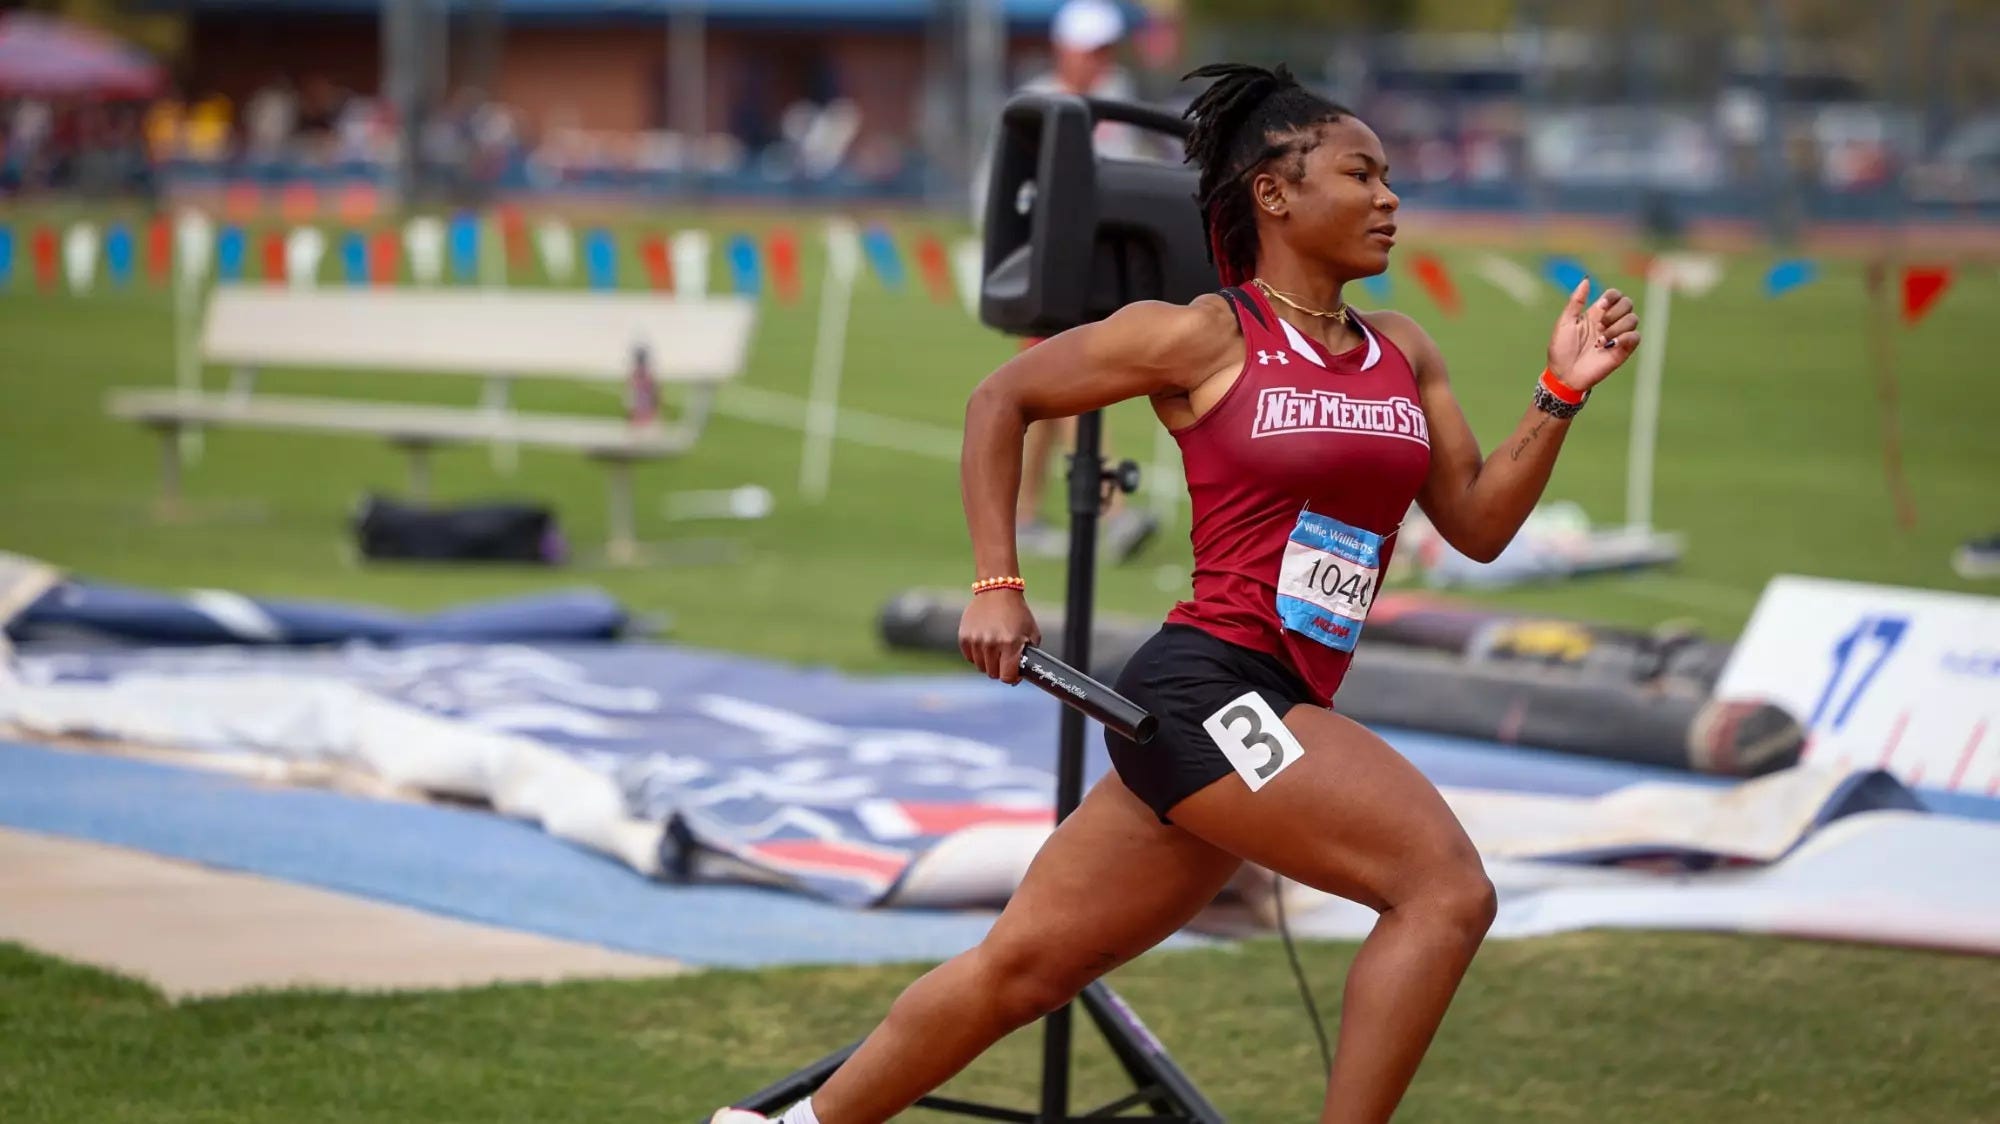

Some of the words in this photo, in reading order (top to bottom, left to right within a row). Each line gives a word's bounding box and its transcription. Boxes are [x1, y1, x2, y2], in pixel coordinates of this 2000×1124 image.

[1394, 402, 1430, 443] STA
[1329, 528, 1374, 555] Williams
[1807, 615, 1910, 732] 17
[1219, 704, 1284, 780] 3
